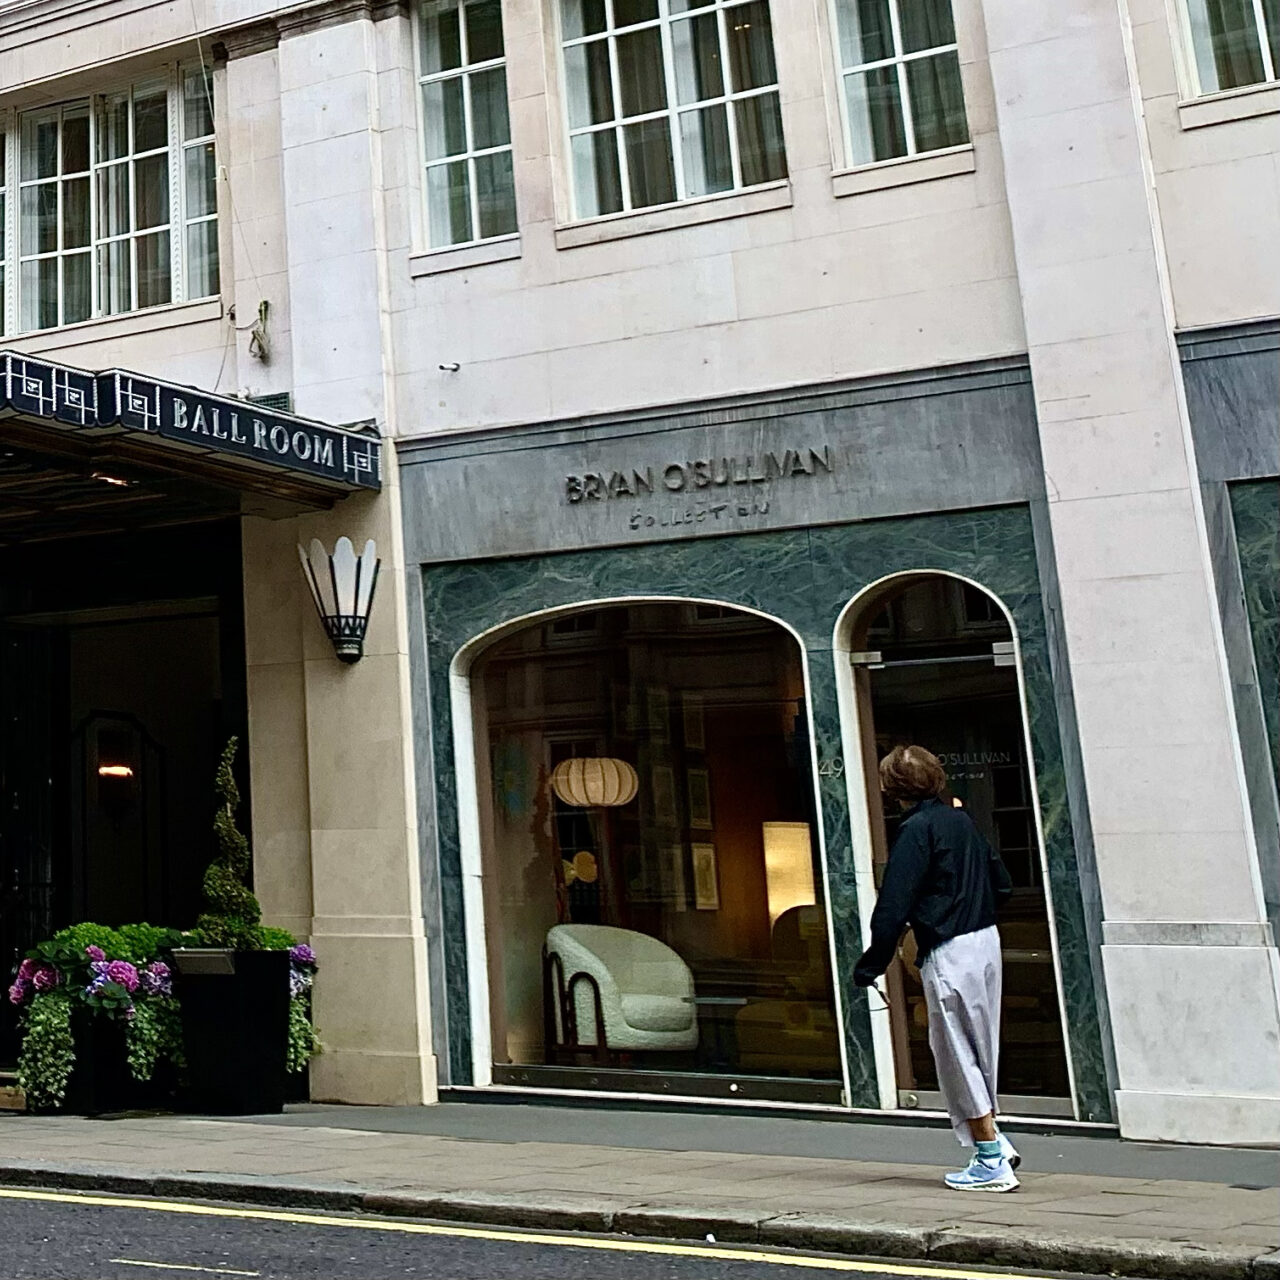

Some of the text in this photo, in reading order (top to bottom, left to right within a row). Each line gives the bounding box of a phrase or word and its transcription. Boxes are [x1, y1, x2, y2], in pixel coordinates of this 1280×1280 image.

[564, 444, 833, 505] BRYAN O'SULLIVAN
[628, 499, 770, 531] COLECTON
[819, 756, 845, 779] 49
